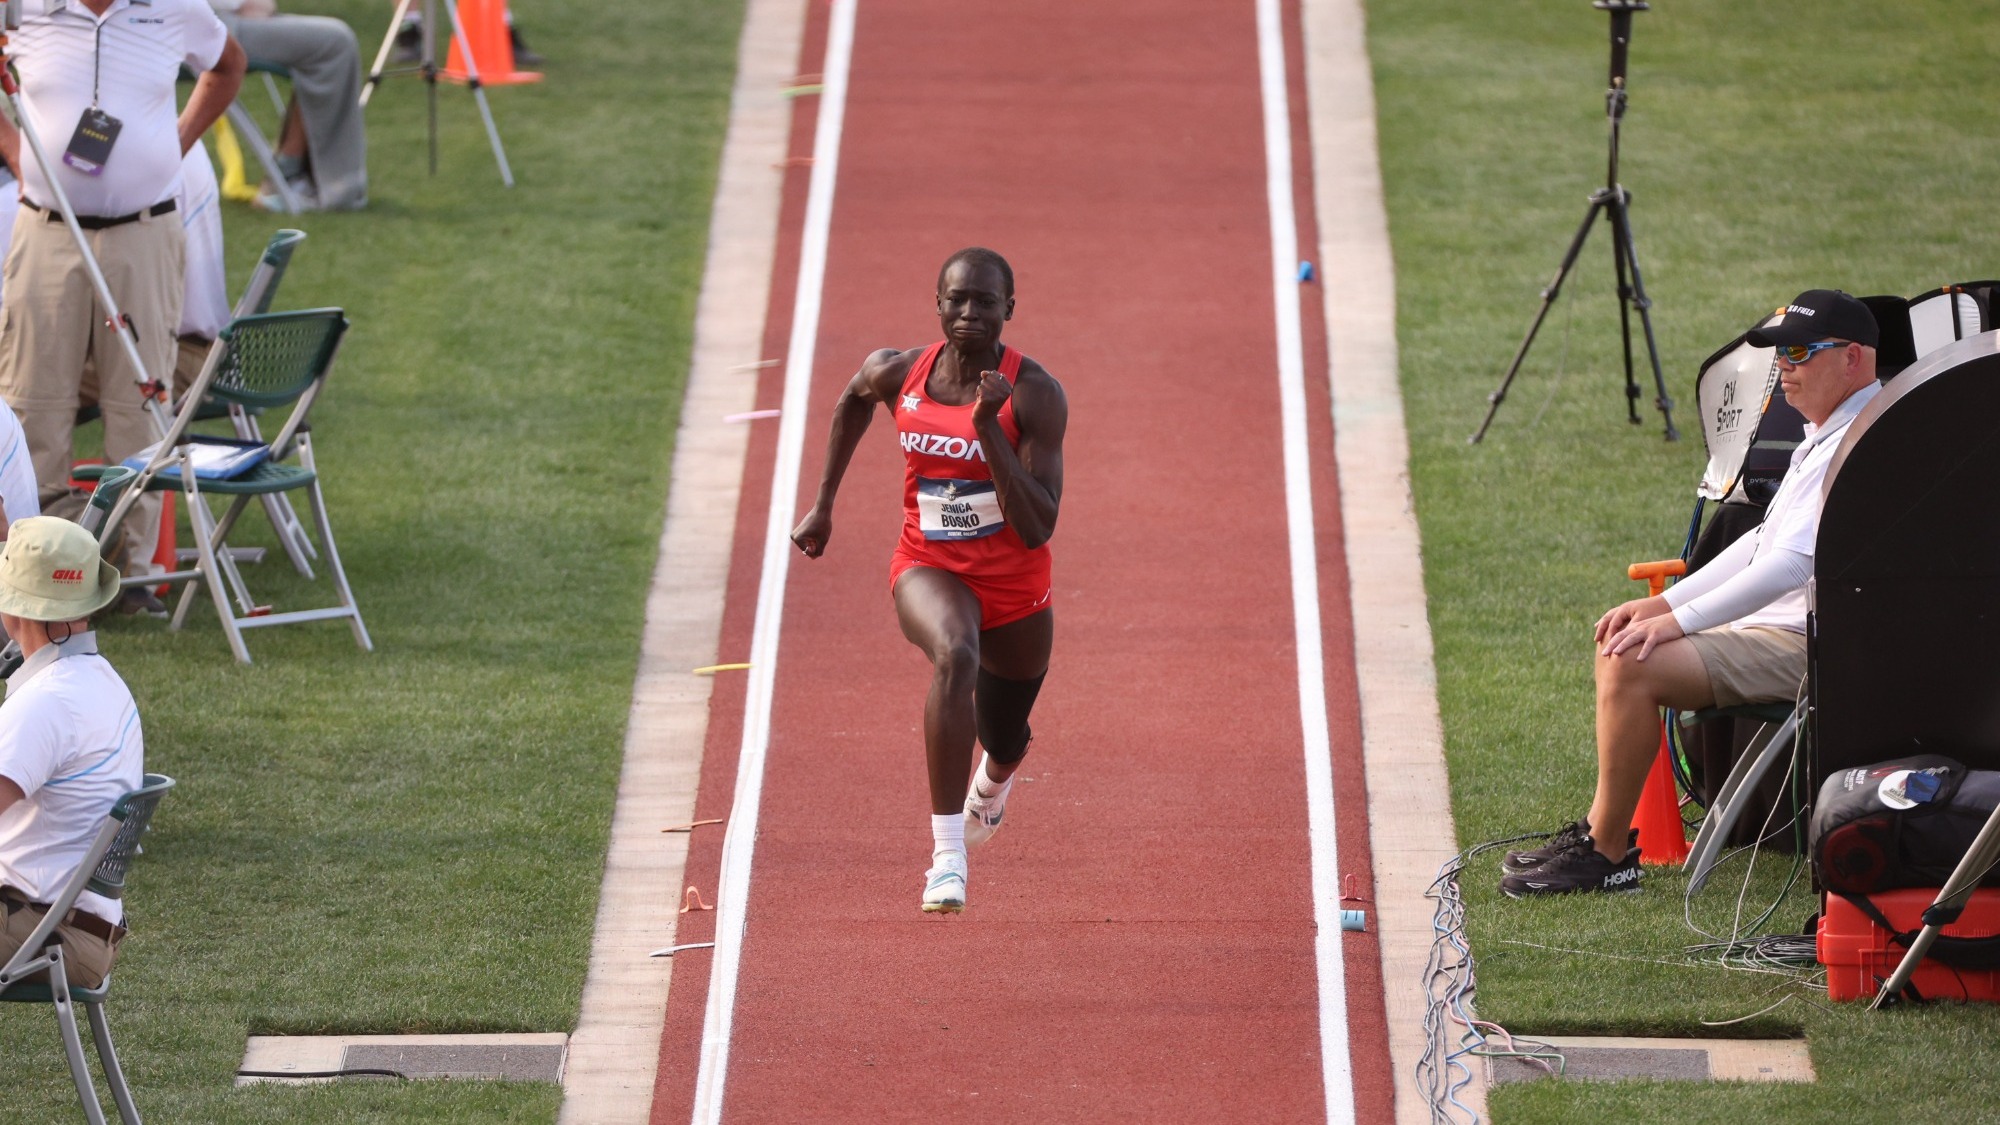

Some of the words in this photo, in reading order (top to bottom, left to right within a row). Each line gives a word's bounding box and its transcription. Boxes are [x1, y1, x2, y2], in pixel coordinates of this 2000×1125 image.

[1796, 306, 1816, 317] FIELD
[1723, 380, 1737, 407] DV
[1716, 407, 1743, 432] SPORT
[900, 431, 986, 462] ARIZON
[941, 502, 973, 514] JENICA
[941, 513, 980, 528] BOSKO
[52, 569, 83, 580] GILL
[1603, 867, 1637, 888] HOKA
